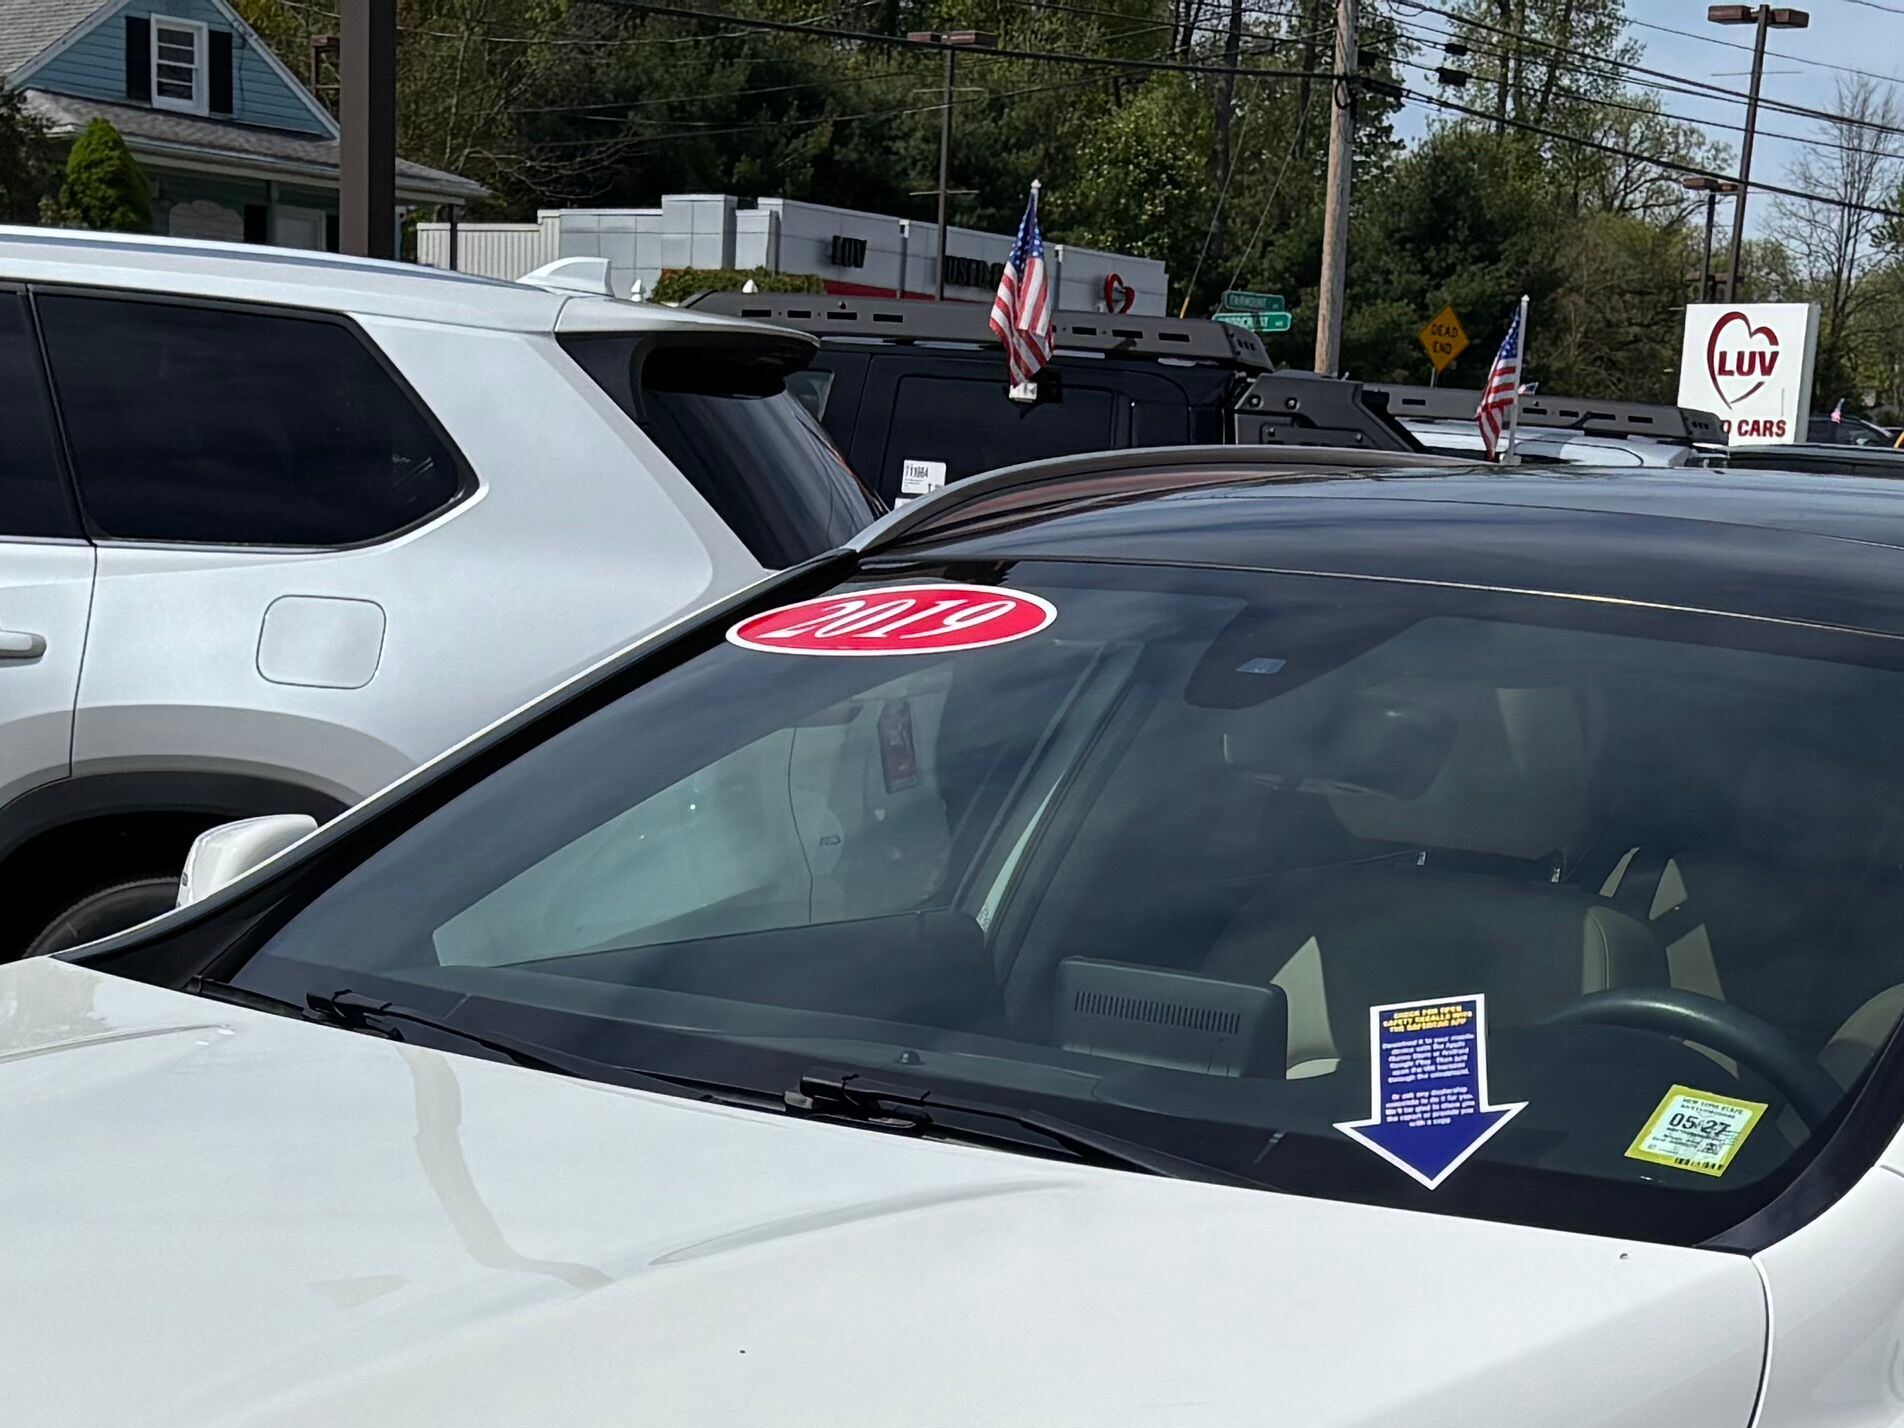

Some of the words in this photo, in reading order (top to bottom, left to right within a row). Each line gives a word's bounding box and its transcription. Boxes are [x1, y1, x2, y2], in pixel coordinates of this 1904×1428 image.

[1432, 323, 1458, 338] DEAD
[1433, 341, 1452, 355] END
[1717, 351, 1780, 377] LUV
[1737, 419, 1787, 438] CARS
[755, 599, 1017, 639] 2019
[1669, 1112, 1696, 1130] 05
[1700, 1119, 1731, 1137] 27
